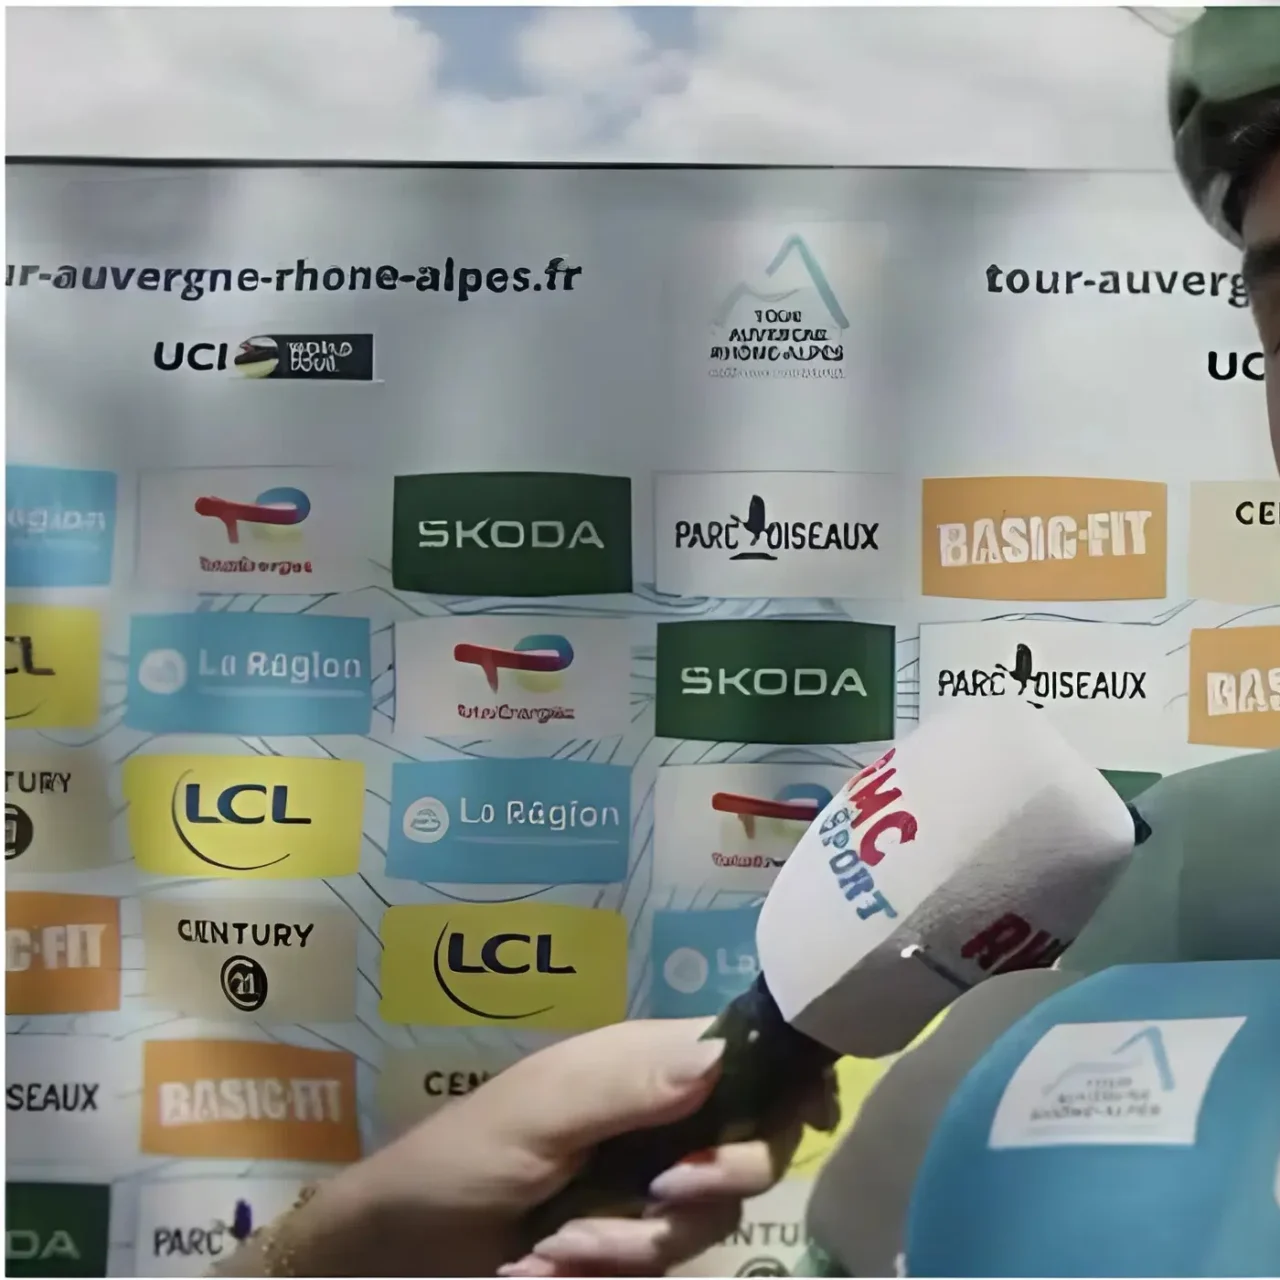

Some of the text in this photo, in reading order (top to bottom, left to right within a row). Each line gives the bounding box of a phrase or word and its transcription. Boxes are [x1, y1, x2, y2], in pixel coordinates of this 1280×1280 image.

[154, 341, 227, 371] UCI
[185, 783, 312, 825] LCL
[446, 931, 578, 976] LCL
